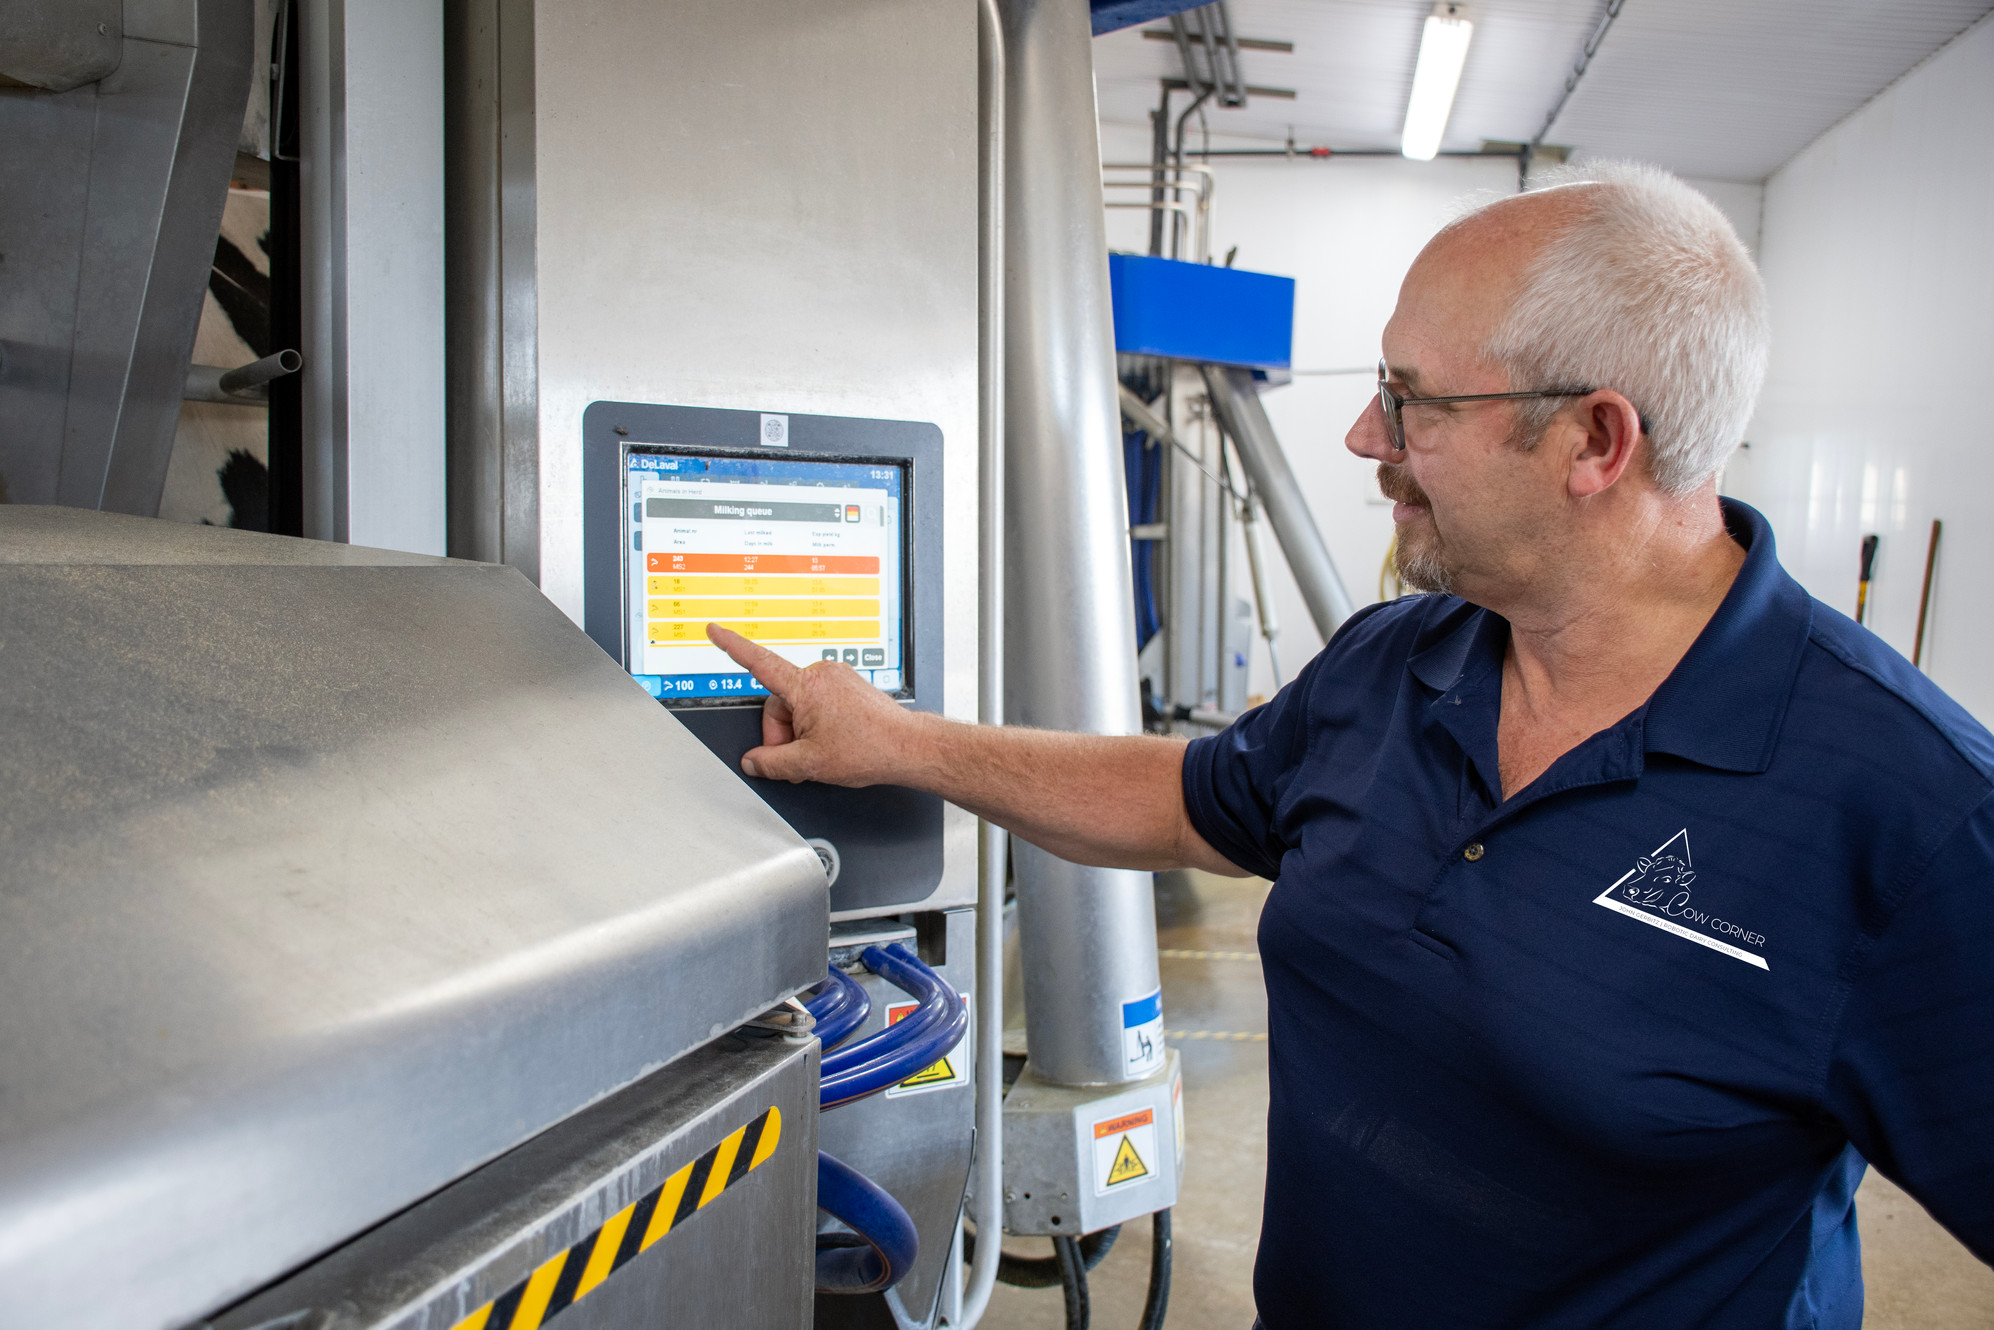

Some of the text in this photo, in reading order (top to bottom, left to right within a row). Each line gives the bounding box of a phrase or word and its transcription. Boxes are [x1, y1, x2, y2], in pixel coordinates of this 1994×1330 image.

[641, 460, 678, 470] DeLaval
[871, 470, 894, 480] 13:31
[714, 505, 773, 517] Milking queue
[864, 653, 883, 661] Close
[675, 680, 694, 691] 100
[721, 679, 742, 690] 13.4
[1618, 905, 1636, 916] JOHN
[1663, 922, 1689, 937] ROBOTIC
[1689, 932, 1708, 944] DAIRY
[1707, 939, 1743, 958] CONSULTING
[1710, 918, 1766, 947] CORNER
[1108, 1114, 1148, 1132] WARNING
